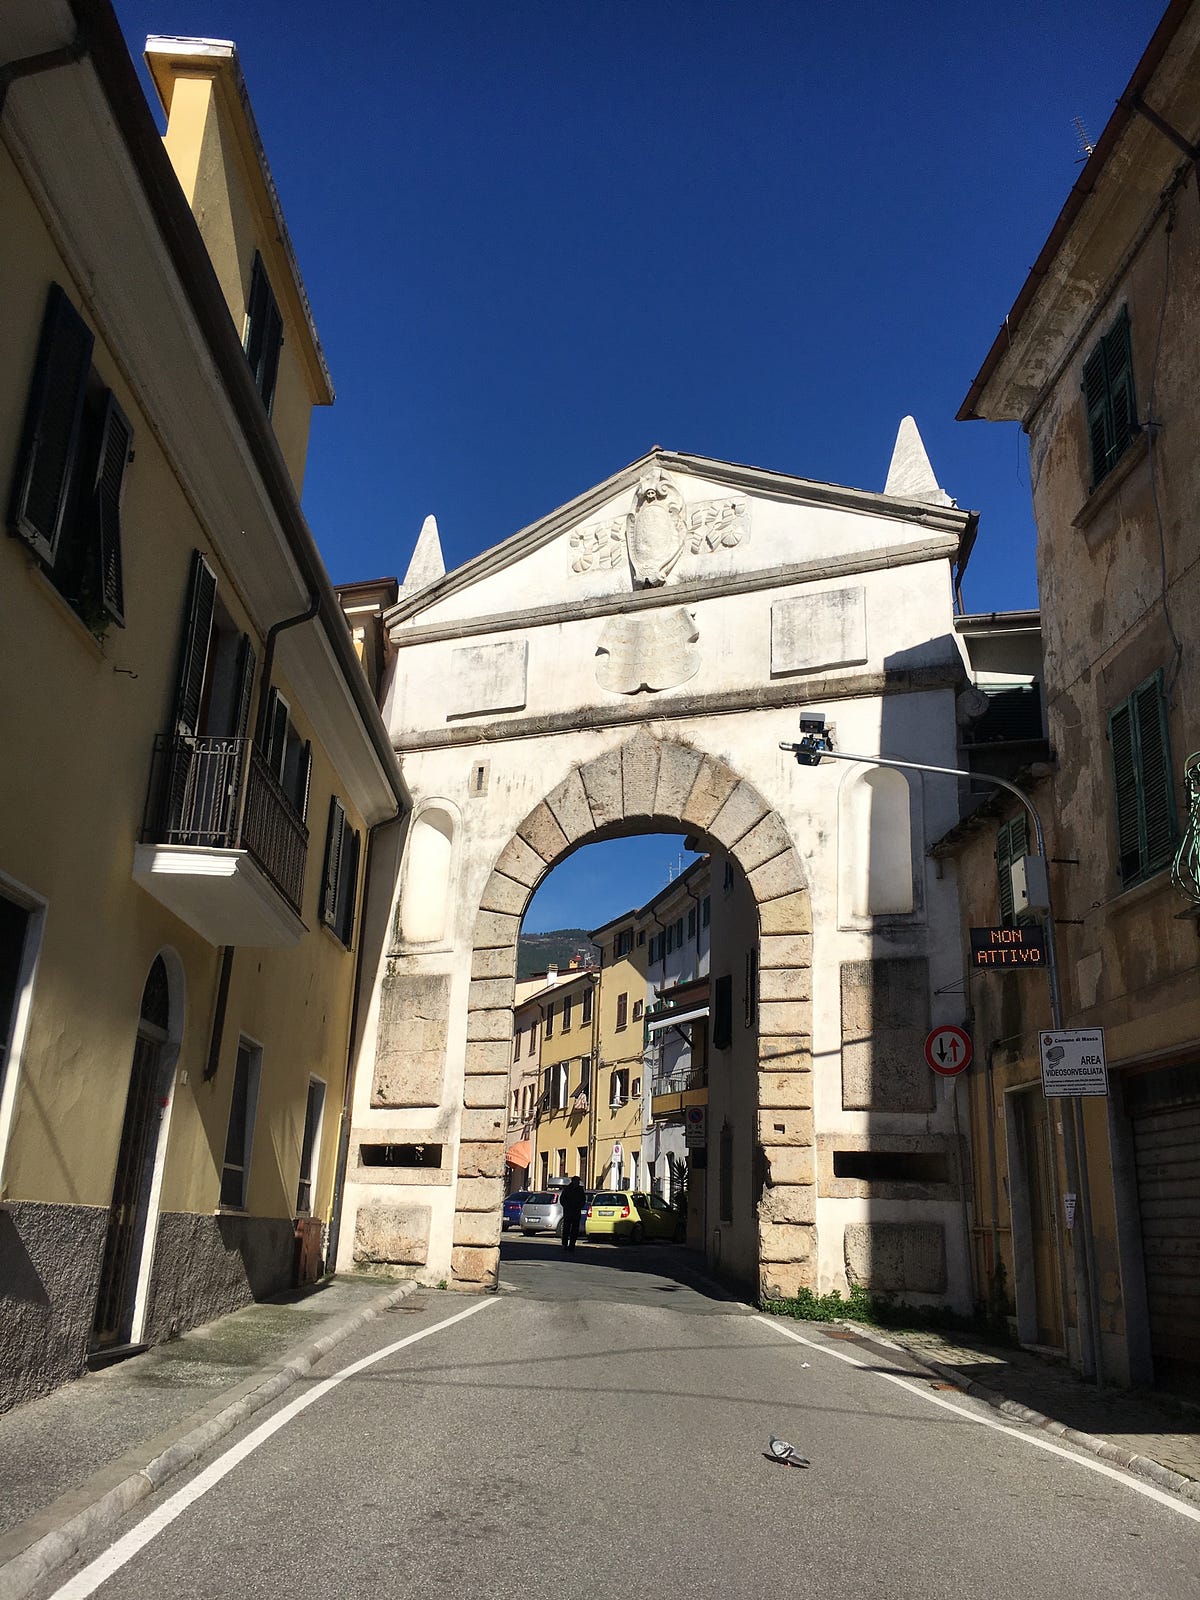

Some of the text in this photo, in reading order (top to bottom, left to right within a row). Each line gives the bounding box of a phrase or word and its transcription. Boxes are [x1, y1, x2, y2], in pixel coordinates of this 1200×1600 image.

[990, 929, 1022, 943] NON
[977, 948, 1040, 963] ATTIVO
[1081, 1055, 1101, 1065] AREA
[1046, 1067, 1104, 1077] VIDEOSORVEGLIATA
